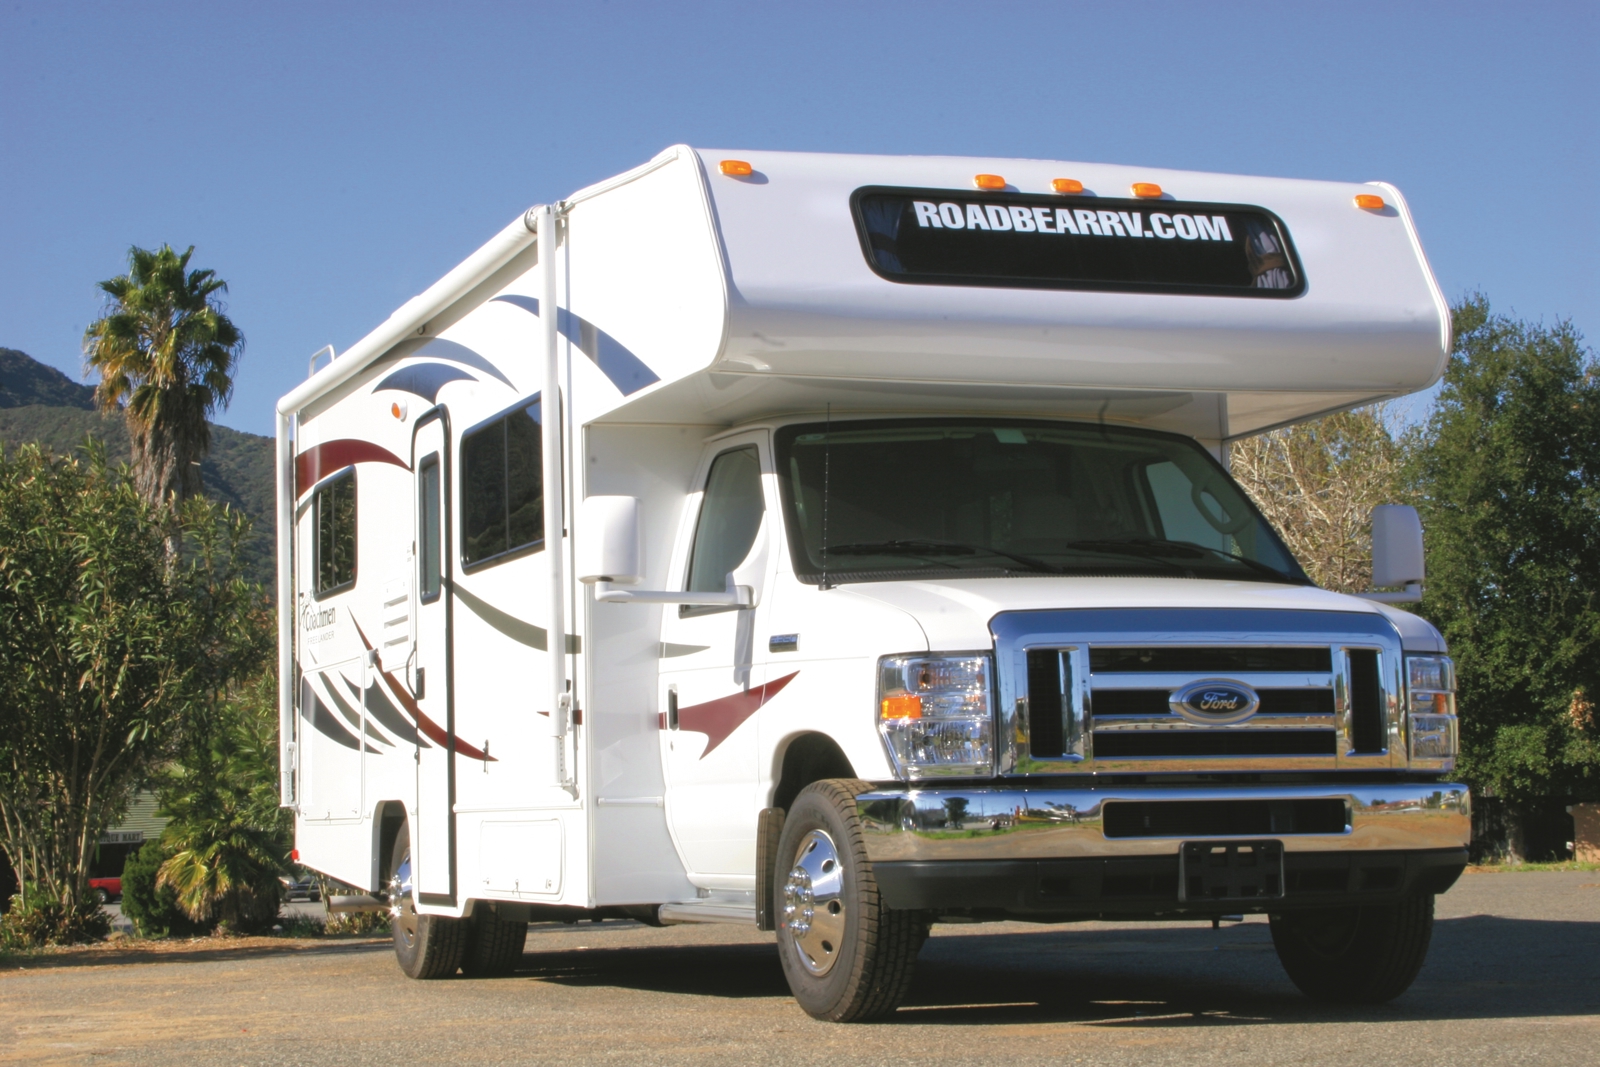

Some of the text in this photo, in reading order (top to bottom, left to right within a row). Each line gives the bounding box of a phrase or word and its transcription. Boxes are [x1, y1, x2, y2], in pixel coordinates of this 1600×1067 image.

[912, 201, 1233, 242] ROADBEARRV.COM
[306, 604, 336, 632] Coachmen
[1200, 692, 1238, 710] Ford
